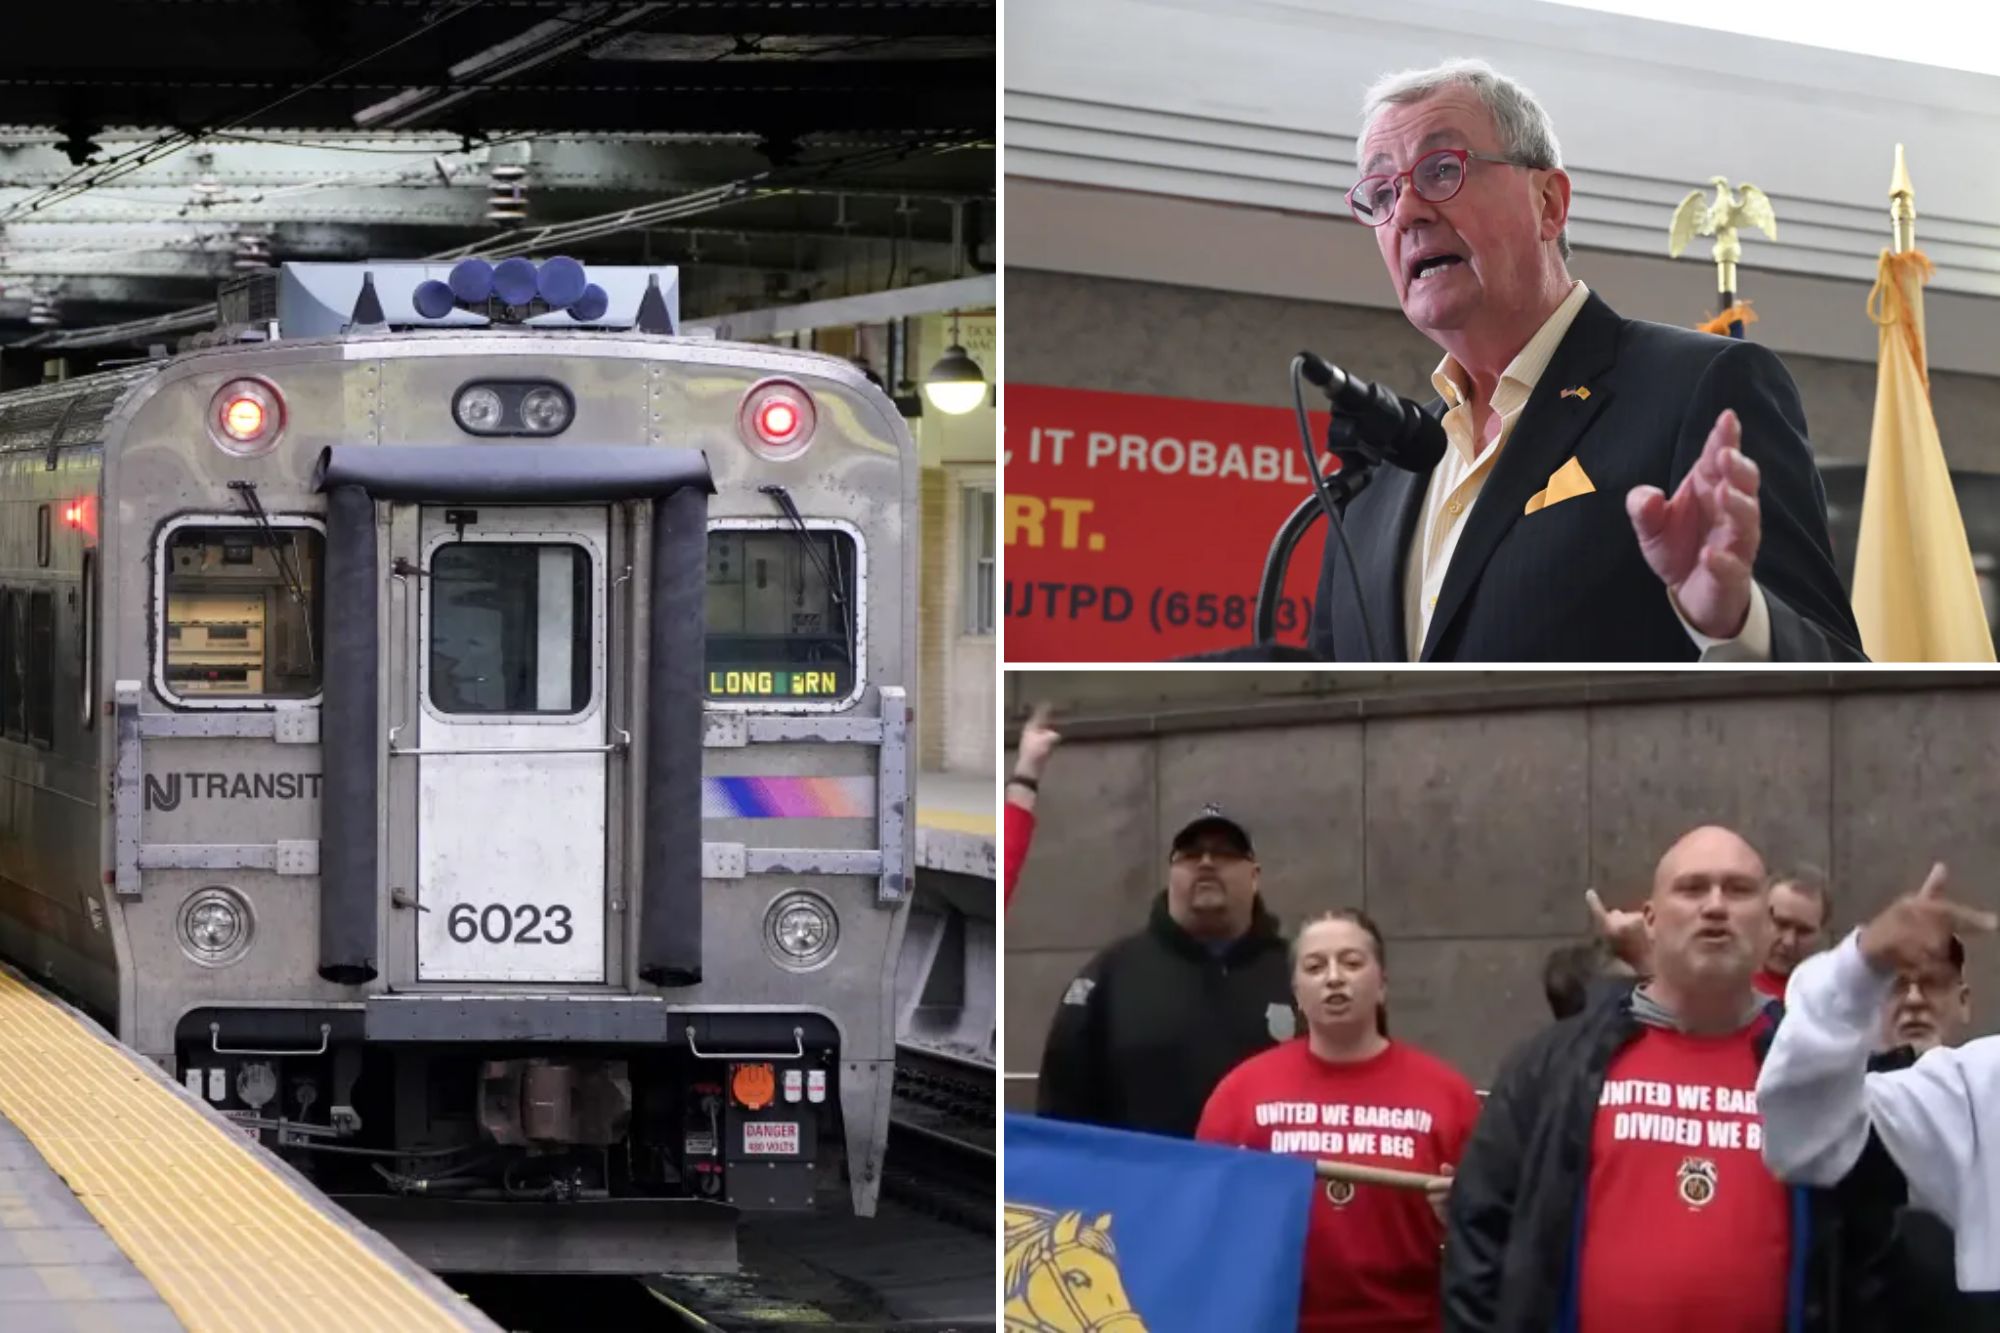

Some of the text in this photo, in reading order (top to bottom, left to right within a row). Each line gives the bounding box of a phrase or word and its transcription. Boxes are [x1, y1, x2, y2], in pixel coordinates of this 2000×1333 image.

[1029, 427, 1075, 465] IT
[1004, 494, 1106, 551] RT.
[1150, 587, 1313, 642] (6583)
[710, 671, 772, 694] LONG
[144, 772, 323, 812] NJ TRANSIT
[447, 902, 574, 945] 6023
[1676, 1084, 1711, 1111] WE
[746, 1125, 796, 1137] DANGER
[1255, 1101, 1432, 1133] UNITED WE BARGAIN
[1614, 1113, 1702, 1146] DIVIDED
[1706, 1120, 1742, 1148] WE
[1270, 1130, 1415, 1159] DIVIDED WE BEG
